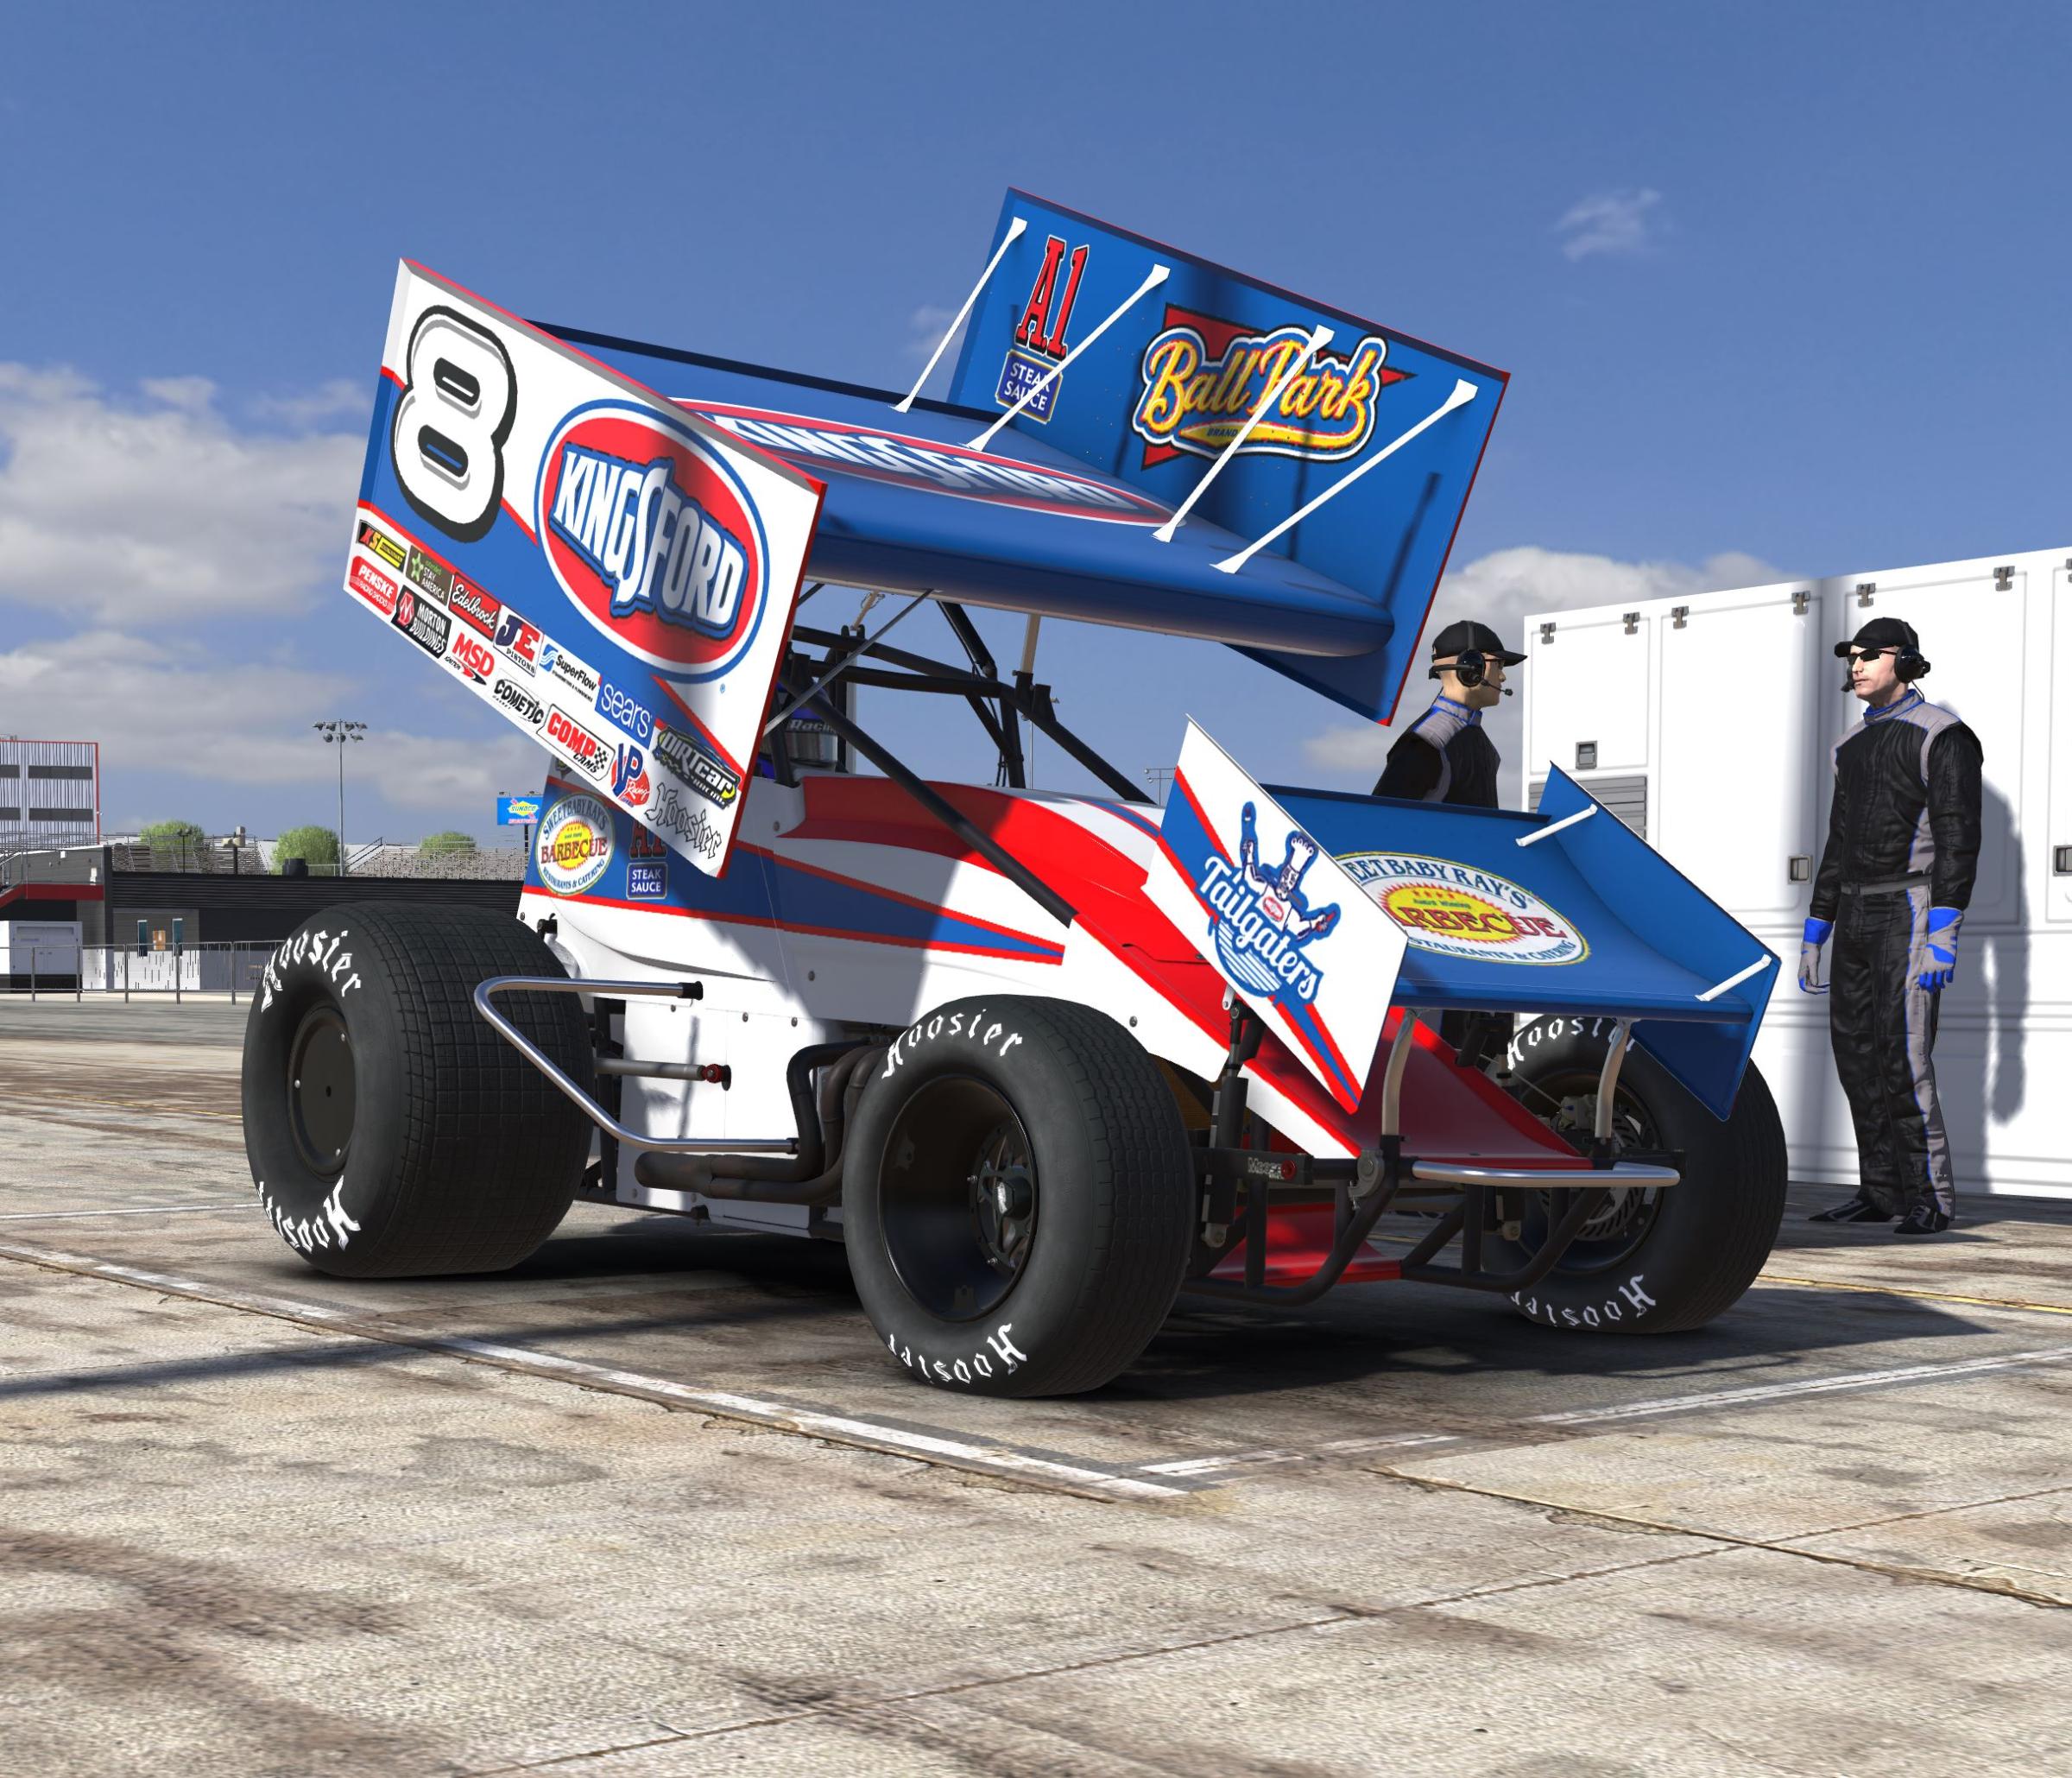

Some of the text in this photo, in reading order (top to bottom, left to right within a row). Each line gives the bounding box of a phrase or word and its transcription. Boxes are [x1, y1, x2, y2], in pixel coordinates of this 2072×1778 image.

[1141, 339, 1373, 432] Ball Park
[392, 306, 516, 541] 8
[551, 447, 746, 629] KINGSFORD
[358, 564, 394, 598] PENSKE
[421, 577, 445, 600] AMERICA
[423, 566, 436, 582] STAY
[417, 603, 446, 633] MORTON
[452, 583, 496, 630] Edelbrock
[409, 619, 447, 655] BUILDINGS
[452, 632, 495, 677] MSD
[495, 614, 540, 662] JE
[506, 648, 535, 674] PISTONS
[556, 654, 597, 691] SuperFlow
[494, 679, 544, 724] COMETIC
[601, 684, 652, 738] sears
[547, 712, 597, 757] COMP
[572, 752, 597, 774] CAMS
[543, 804, 568, 840] SWEET
[566, 799, 587, 815] BABY
[645, 782, 723, 859] Hoosier
[540, 837, 608, 864] BARBECUE
[631, 881, 662, 893] SAUCE
[632, 869, 661, 880] STEAK
[1342, 859, 1528, 909] EET BABY RAY'S
[1200, 856, 1317, 999] Tailgaters
[1383, 906, 1568, 939] RBECUE
[1408, 936, 1576, 960] STAURANTS & CATERING
[262, 930, 361, 1013] Hoosier
[881, 1009, 1023, 1079] Hoosier
[888, 1323, 1027, 1384] Hoosier
